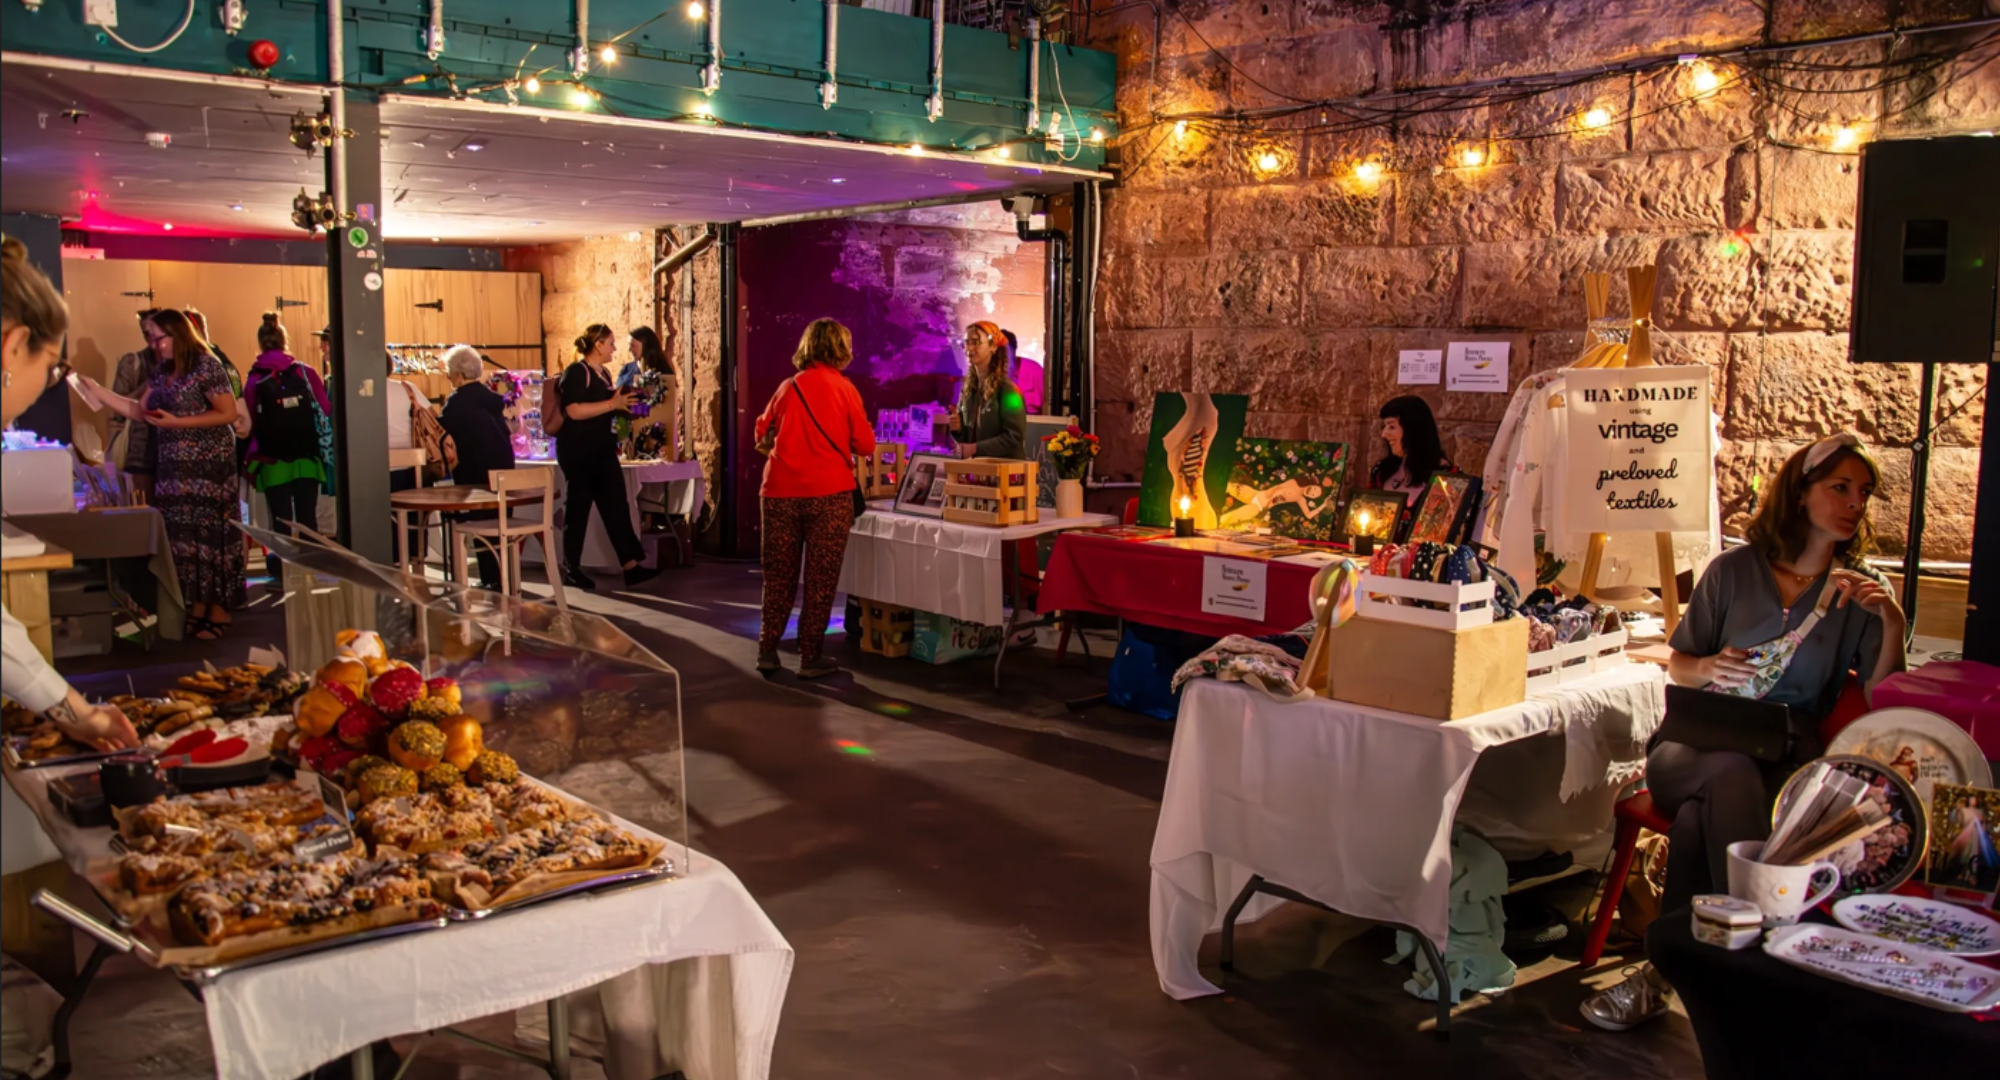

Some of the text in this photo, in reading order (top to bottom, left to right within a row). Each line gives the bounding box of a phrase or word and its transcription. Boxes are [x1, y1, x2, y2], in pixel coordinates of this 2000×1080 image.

[1584, 386, 1698, 402] HANDMADE
[1629, 407, 1652, 415] using
[1598, 419, 1679, 444] vintage
[1629, 446, 1645, 454] and
[1596, 458, 1679, 490] preloved
[1606, 488, 1679, 510] textiles
